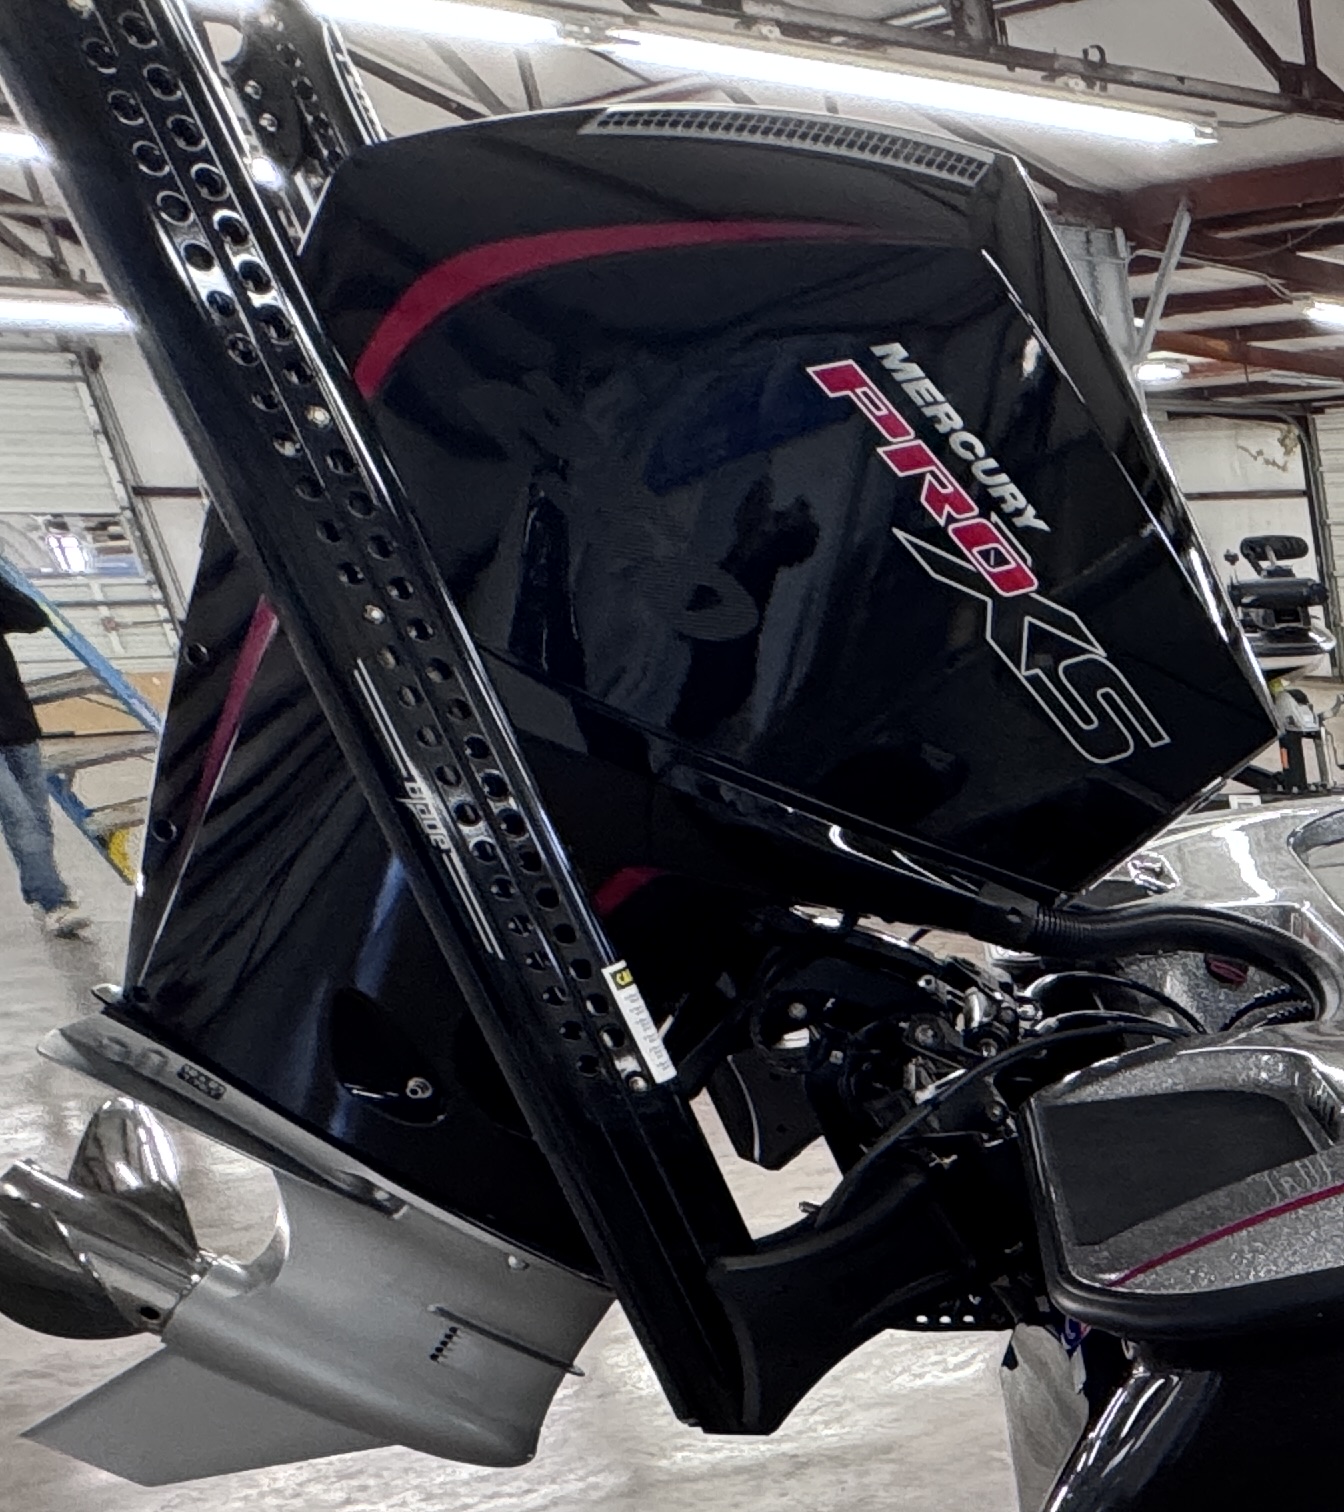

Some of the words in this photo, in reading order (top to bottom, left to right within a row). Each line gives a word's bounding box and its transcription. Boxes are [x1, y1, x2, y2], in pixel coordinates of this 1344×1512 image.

[806, 358, 1038, 598] PRO
[870, 341, 1051, 532] MERCURY
[892, 512, 1171, 764] XS
